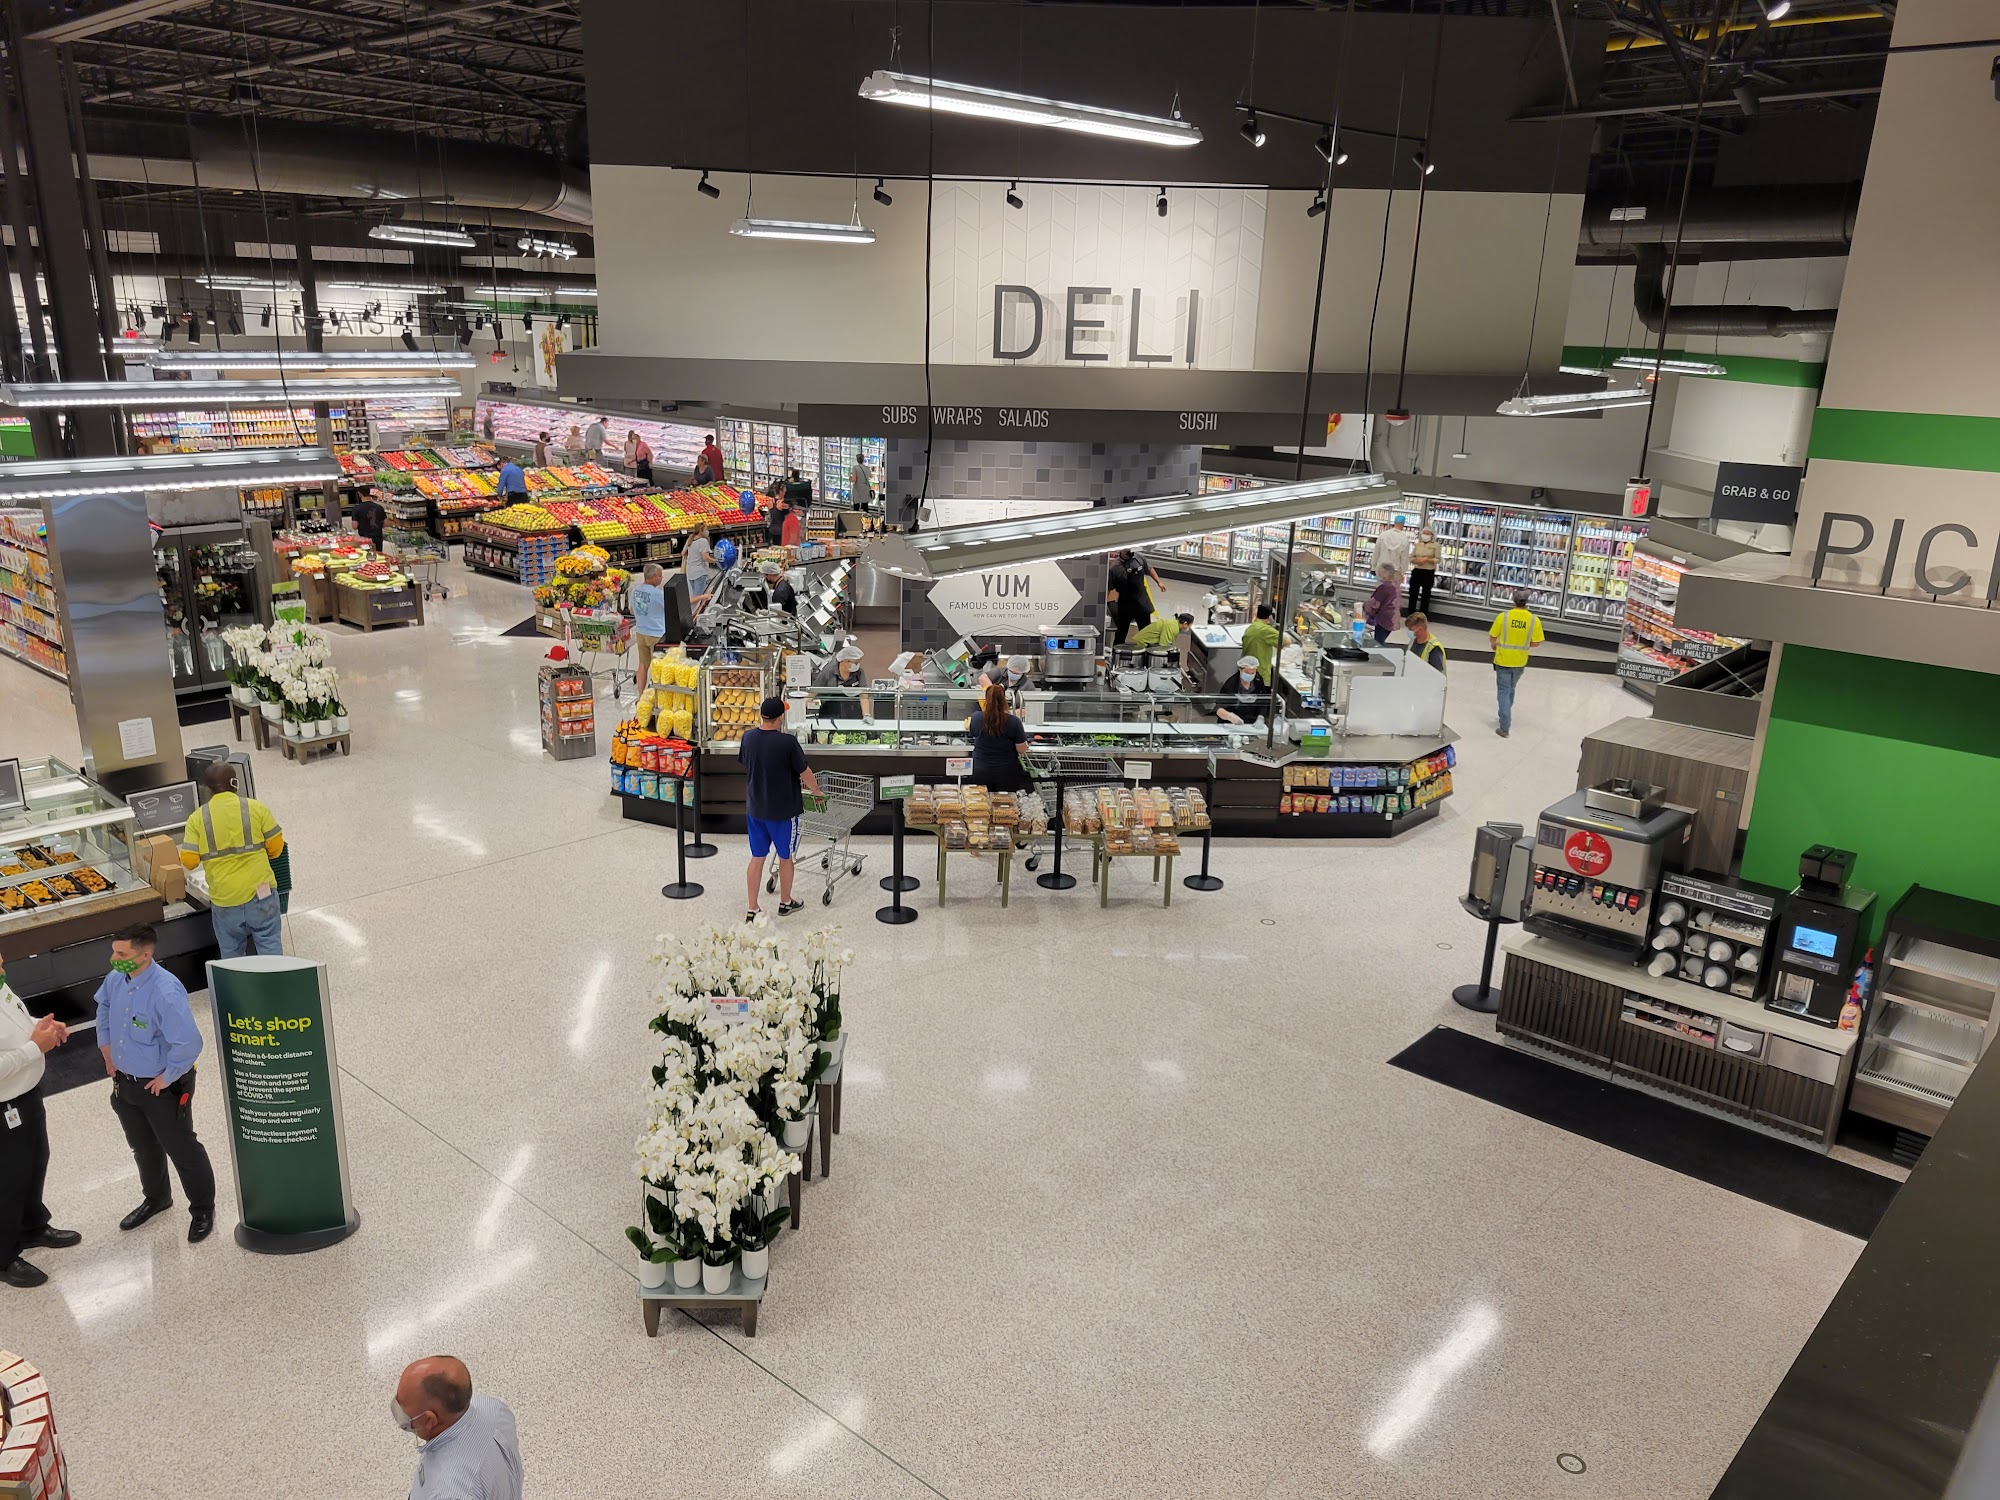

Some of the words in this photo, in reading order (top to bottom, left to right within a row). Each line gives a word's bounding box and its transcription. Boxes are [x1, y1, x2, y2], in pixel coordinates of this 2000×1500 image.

[993, 284, 1199, 363] DELI
[882, 406, 917, 425] SUBS
[933, 406, 983, 426] WRAPS
[998, 408, 1049, 428] SALADS
[1179, 412, 1218, 431] SUSHI
[1721, 485, 1757, 498] GRAB
[1760, 488, 1769, 500] &
[1772, 489, 1791, 501] GO
[981, 574, 1030, 598] YUM
[949, 601, 988, 610] FAMOUS
[992, 602, 1030, 611] CUSTOM
[1034, 602, 1059, 611] SUBS
[1511, 619, 1527, 630] ECUA
[1684, 642, 1720, 653] HOME-STYLE
[1672, 648, 1687, 656] EASY
[1687, 649, 1706, 659] MEALS
[1620, 662, 1640, 672] CLASSIC
[1568, 845, 1606, 865] Coca-Cola
[1671, 875, 1694, 885] FOUNTAIN
[1693, 880, 1711, 890] DRINKS
[1736, 892, 1755, 901] COFFEE
[227, 1012, 262, 1031] Let's
[266, 1017, 311, 1032] shop
[230, 1032, 280, 1046] smart.
[232, 1049, 257, 1059] Maintain
[261, 1051, 283, 1060] 6-foot
[283, 1050, 313, 1059] distance
[234, 1069, 244, 1077] Use
[249, 1071, 262, 1079] face
[262, 1072, 293, 1080] covering
[248, 1078, 268, 1086] mouth
[236, 1082, 248, 1091] help
[248, 1085, 273, 1093] prevent
[272, 1085, 285, 1093] the
[285, 1084, 310, 1094] spread
[243, 1091, 274, 1100] COVID-19.
[239, 1106, 255, 1114] Wash
[254, 1109, 269, 1117] your
[289, 1107, 321, 1116] regularly
[240, 1114, 252, 1122] with
[252, 1116, 267, 1124] soap
[241, 1126, 251, 1135] Try
[250, 1127, 286, 1137] contactless
[286, 1127, 318, 1138] payment
[250, 1135, 283, 1144] touch-free
[283, 1135, 318, 1143] checkout.
